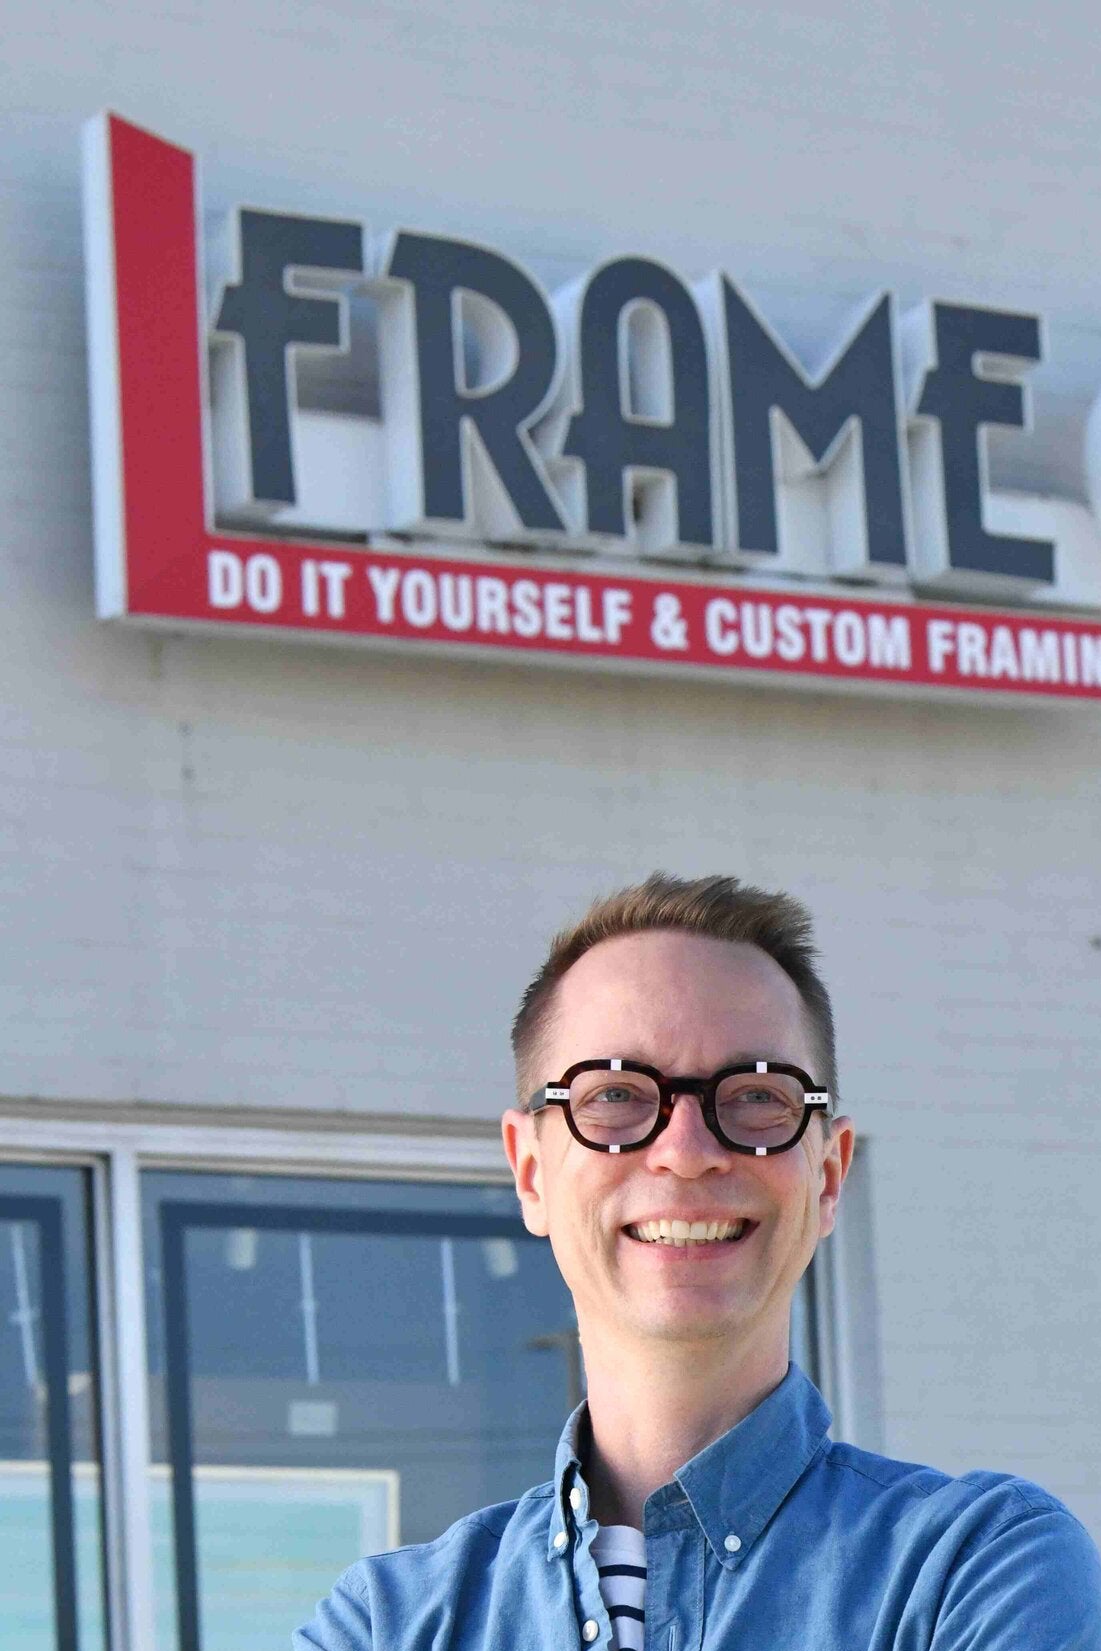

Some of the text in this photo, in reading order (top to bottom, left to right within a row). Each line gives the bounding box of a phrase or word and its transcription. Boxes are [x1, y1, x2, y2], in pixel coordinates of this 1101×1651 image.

[213, 207, 1056, 585] FRAME
[206, 551, 283, 614] DO
[301, 559, 352, 619] IT
[366, 565, 633, 645] YOURSELF
[650, 593, 689, 651] &
[705, 597, 911, 670] CUSTOM
